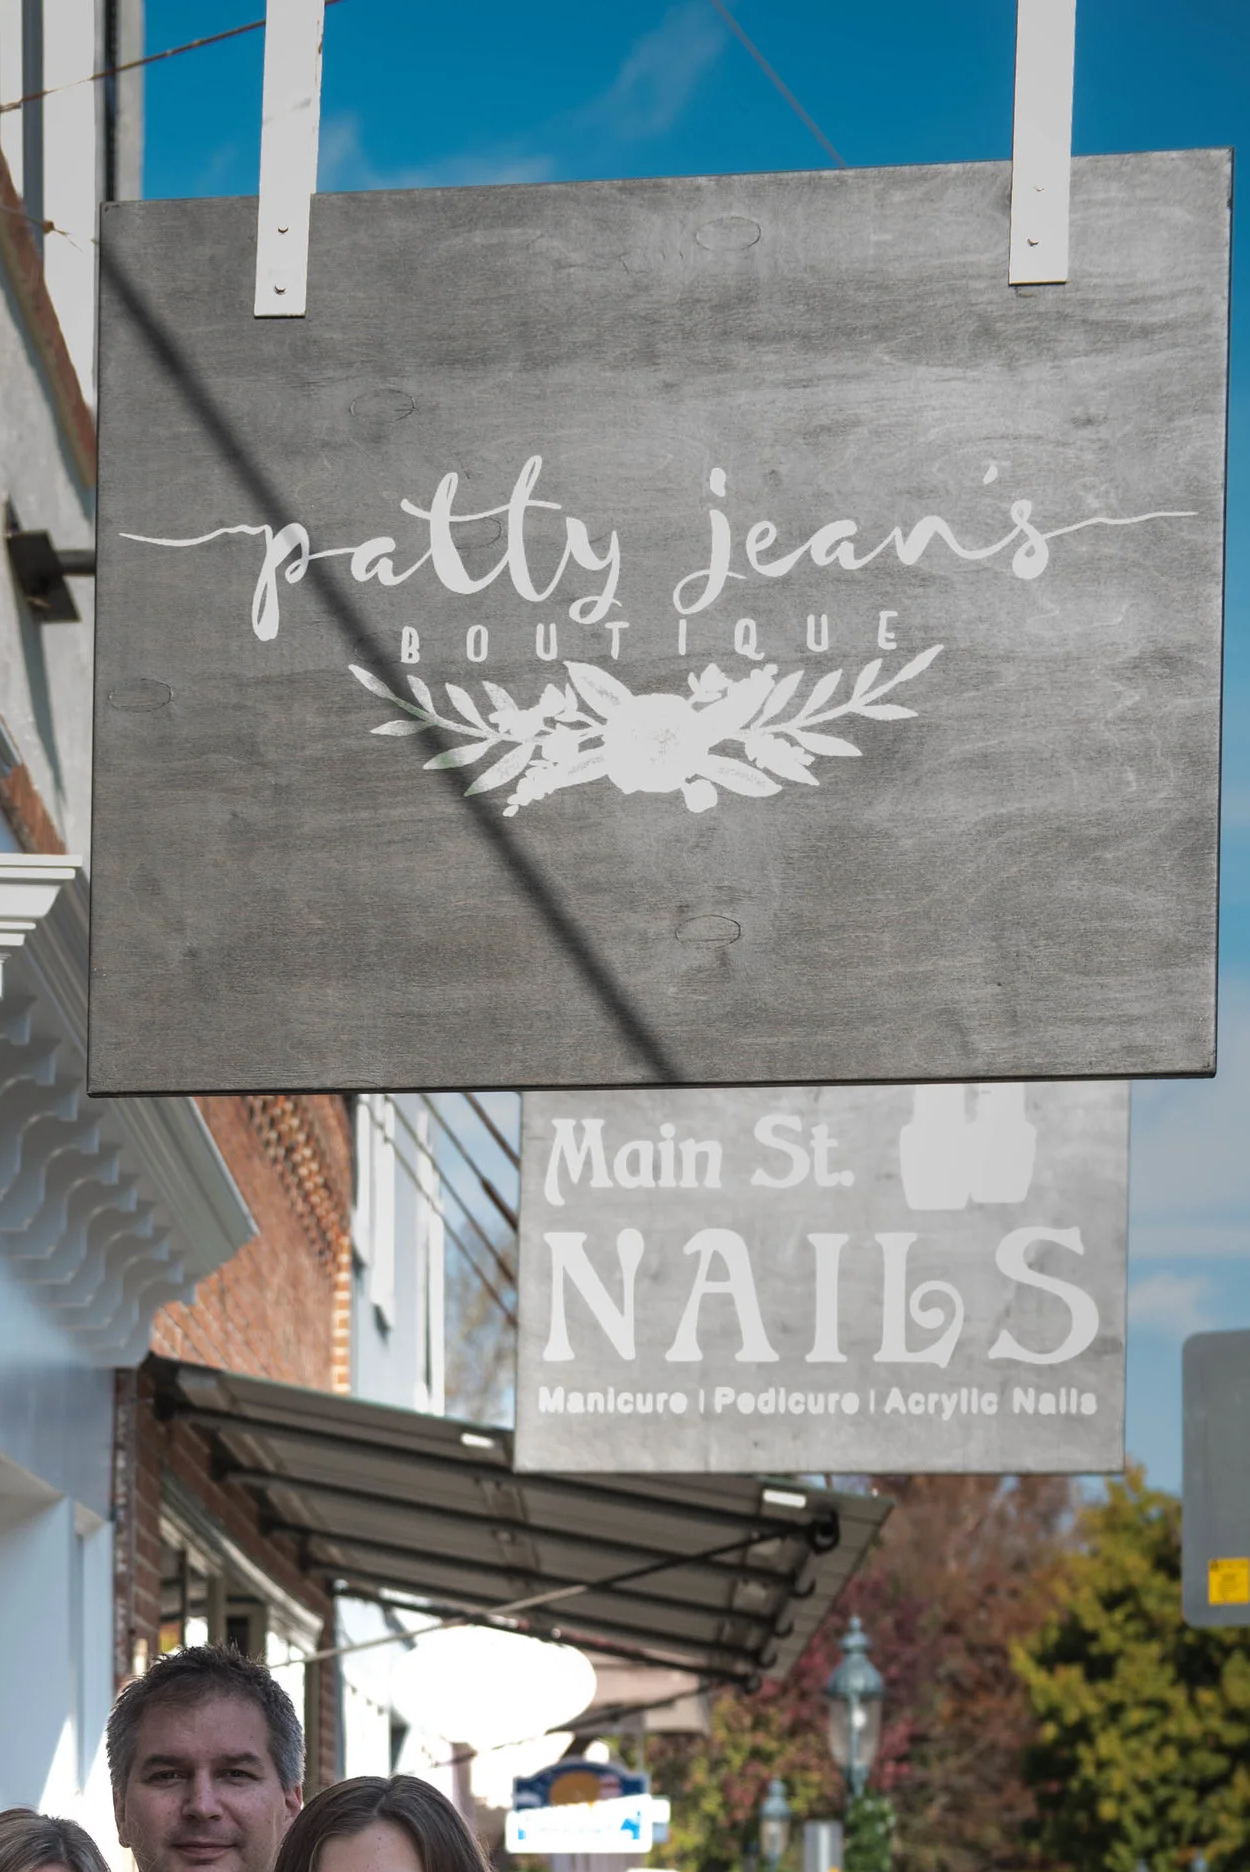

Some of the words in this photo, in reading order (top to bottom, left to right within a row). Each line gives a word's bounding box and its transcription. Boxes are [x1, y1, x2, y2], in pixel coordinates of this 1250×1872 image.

[120, 455, 623, 640] patty
[672, 457, 1198, 615] jean's
[400, 611, 899, 664] BOUTIQUE
[544, 1118, 723, 1206] Main
[749, 1113, 856, 1189] St.
[543, 1226, 1099, 1369] NAILS
[538, 1386, 688, 1415] Manicure
[713, 1387, 860, 1415] Pedicure
[883, 1387, 998, 1422] Acrylic
[1012, 1387, 1098, 1416] Nails
